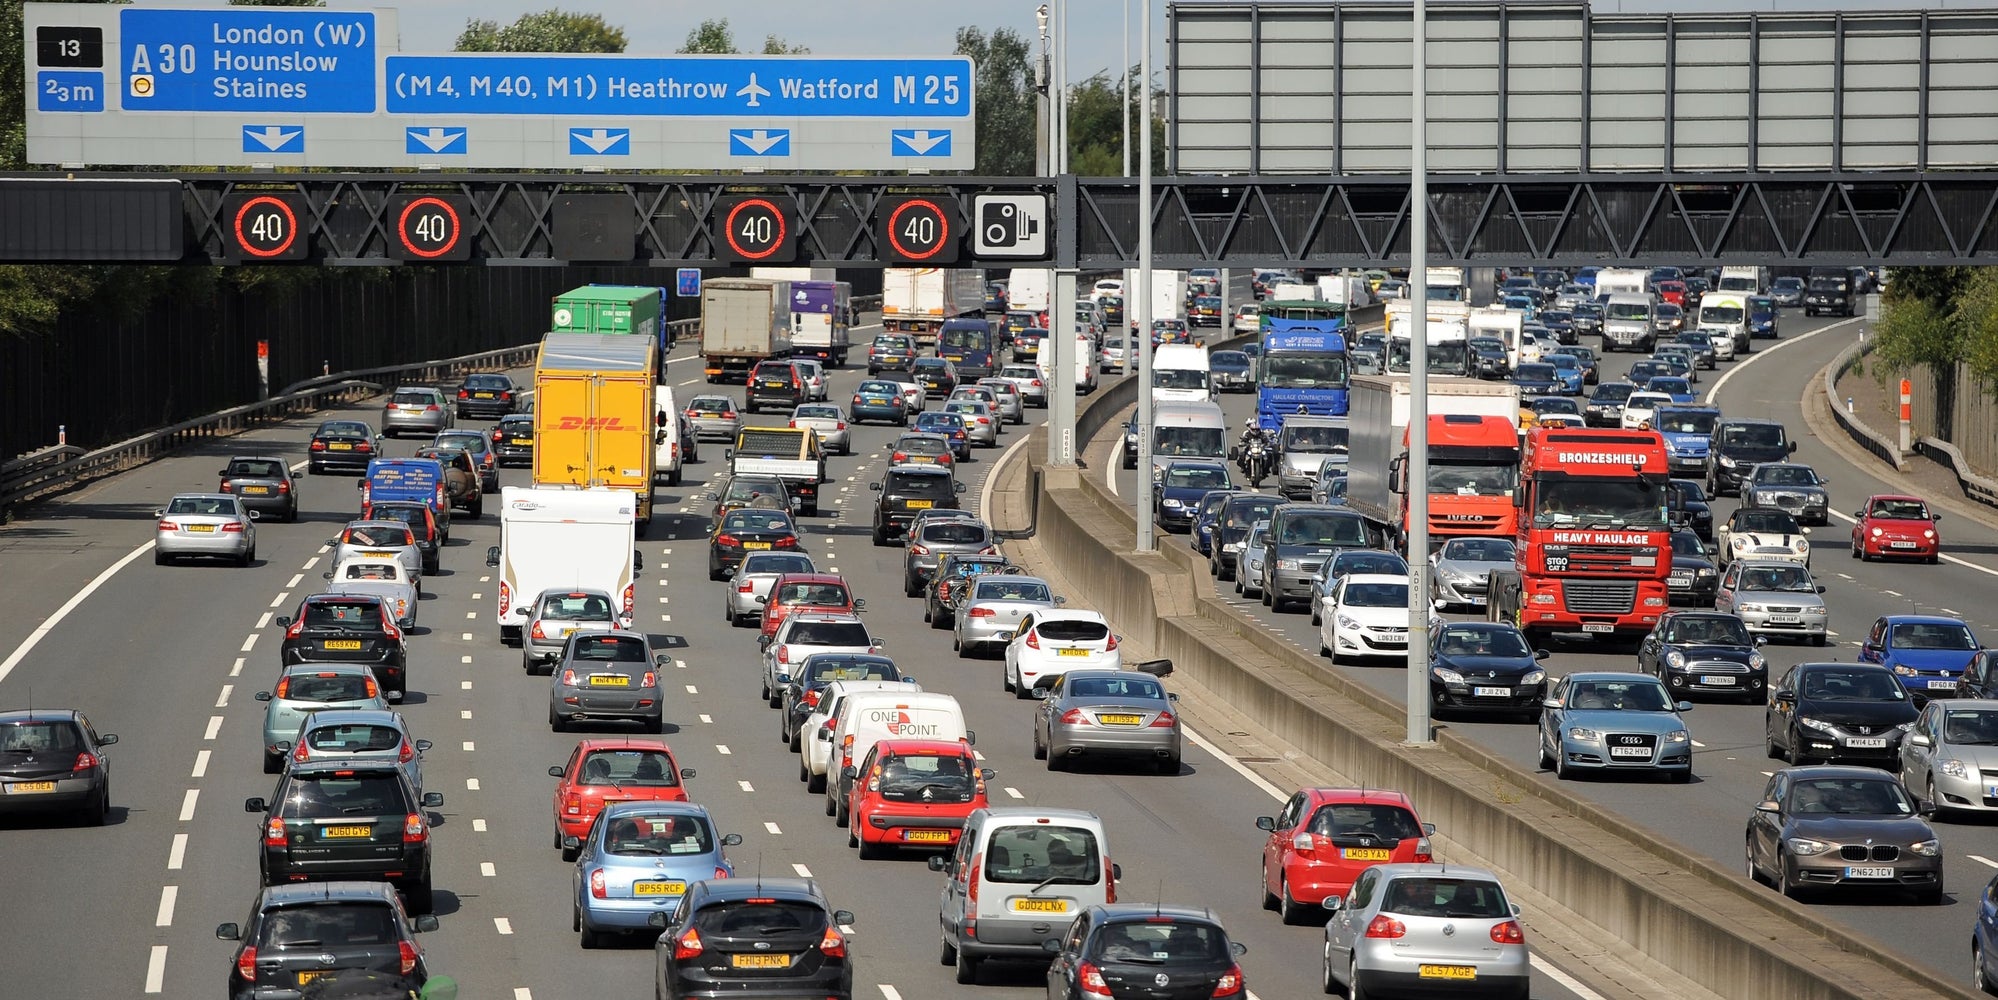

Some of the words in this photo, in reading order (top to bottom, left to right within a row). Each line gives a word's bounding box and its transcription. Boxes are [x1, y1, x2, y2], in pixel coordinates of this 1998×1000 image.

[213, 22, 304, 45] London
[314, 21, 367, 48] (W)
[58, 39, 80, 57] 13
[213, 50, 338, 72] Hounslow
[213, 77, 307, 99] Staines
[608, 80, 728, 99] Heathrow
[779, 78, 878, 99] Watford
[252, 214, 282, 241] 40
[416, 214, 445, 242] 40
[742, 216, 770, 243] 40
[904, 216, 933, 244] 40
[559, 416, 625, 431] DHL
[1559, 452, 1647, 465] BRONZESHIELD
[1447, 514, 1483, 522] IVECO
[1554, 532, 1592, 543] HEAVY
[1595, 533, 1649, 545] HAULAGE
[1546, 557, 1568, 565] STGO
[870, 711, 898, 723] ONE
[899, 724, 938, 736] POINT
[909, 831, 930, 839] DG07
[931, 831, 948, 840] FPT
[1370, 849, 1388, 859] YAX
[1851, 867, 1874, 877] PN62
[1875, 867, 1892, 877] TCV
[639, 882, 662, 893] BP55
[664, 882, 682, 893] RCF
[1045, 900, 1064, 912] LNX
[738, 955, 762, 966] FH13
[764, 955, 784, 966] PNK
[1424, 965, 1449, 976] GL57
[1451, 966, 1471, 977] XGB
